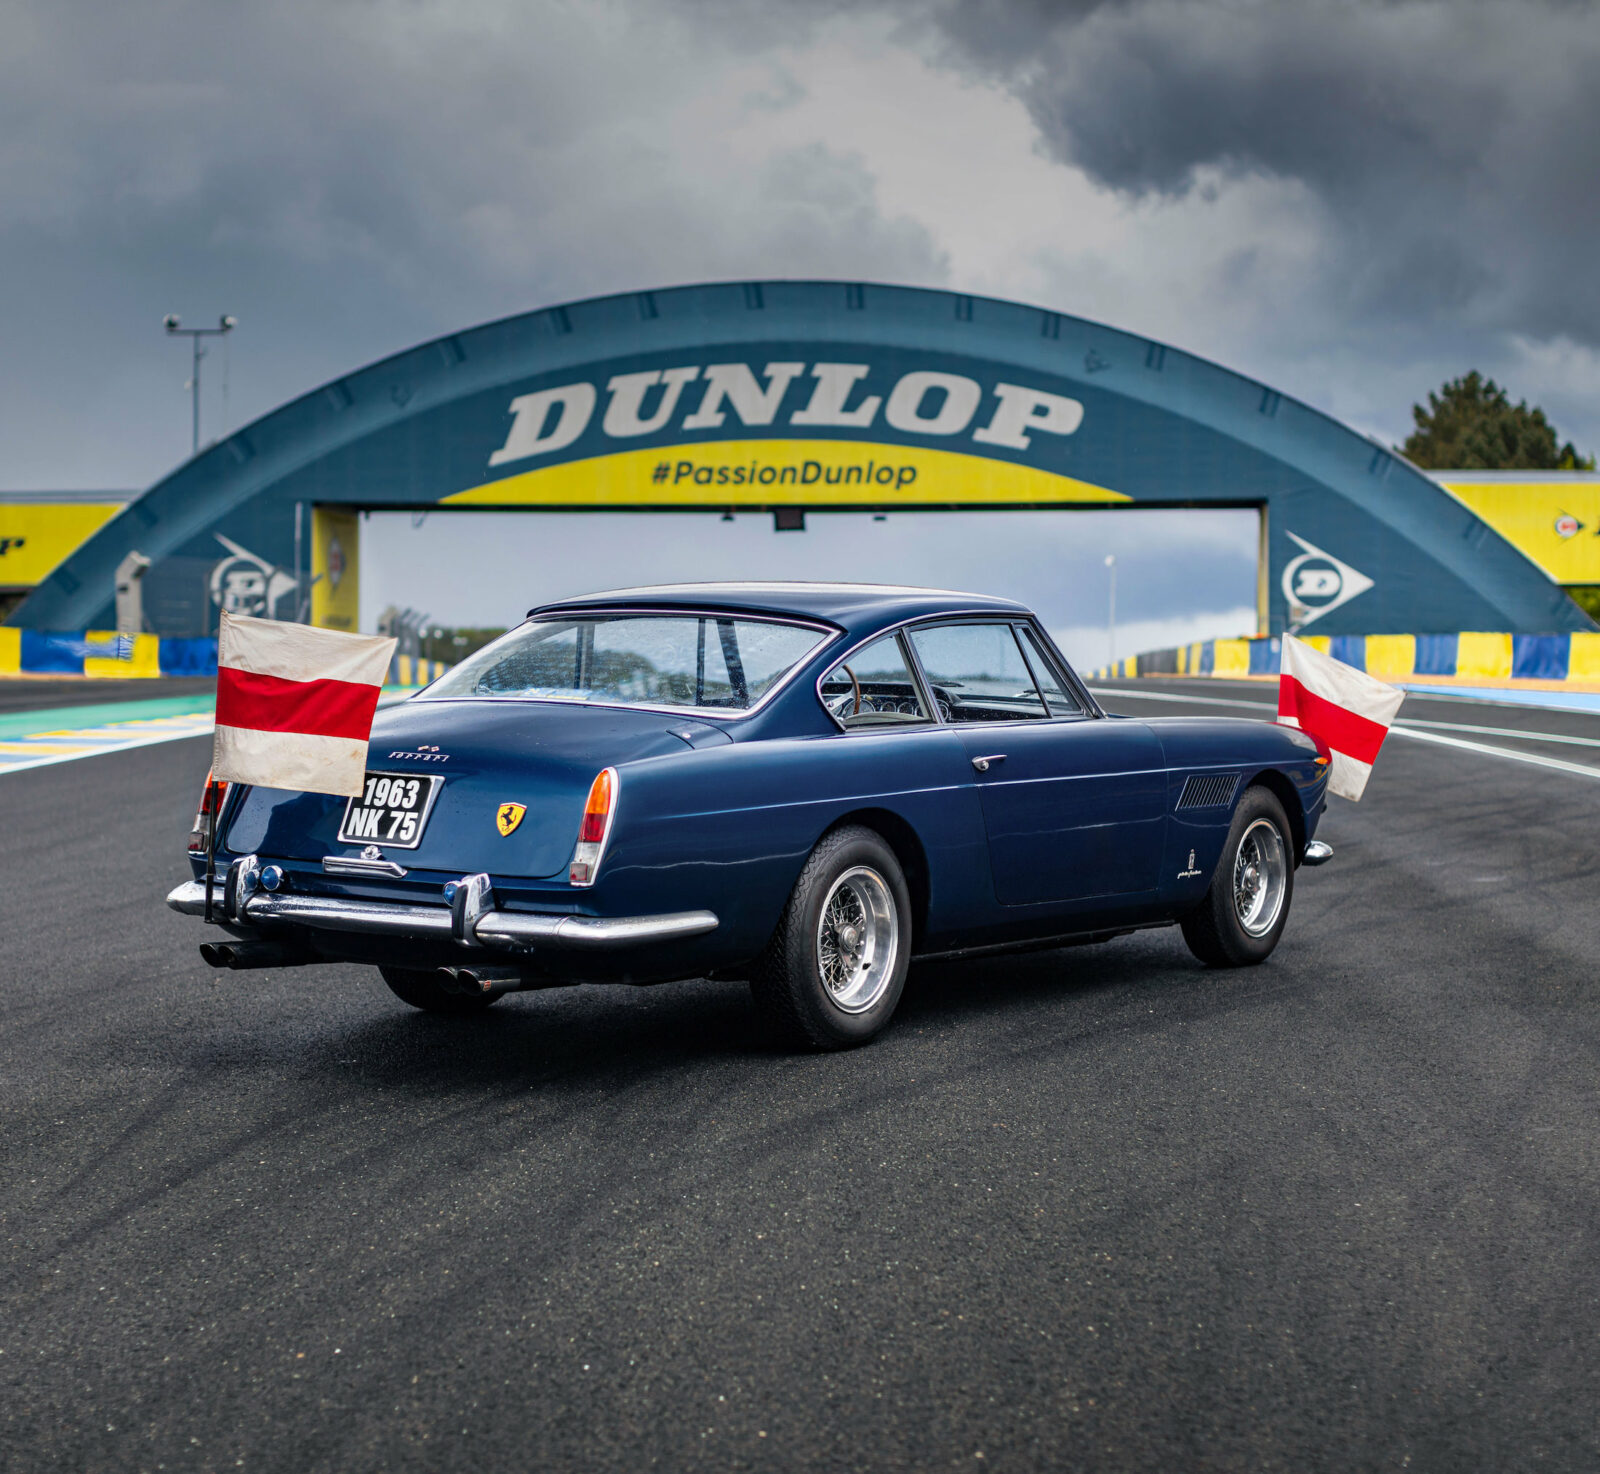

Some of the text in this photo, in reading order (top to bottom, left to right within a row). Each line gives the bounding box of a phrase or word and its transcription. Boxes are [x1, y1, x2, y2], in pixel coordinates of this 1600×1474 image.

[488, 362, 1085, 467] DUNLOP
[651, 460, 917, 490] #PassionDunlop
[363, 777, 421, 809] 1963
[346, 807, 419, 841] NK 75
